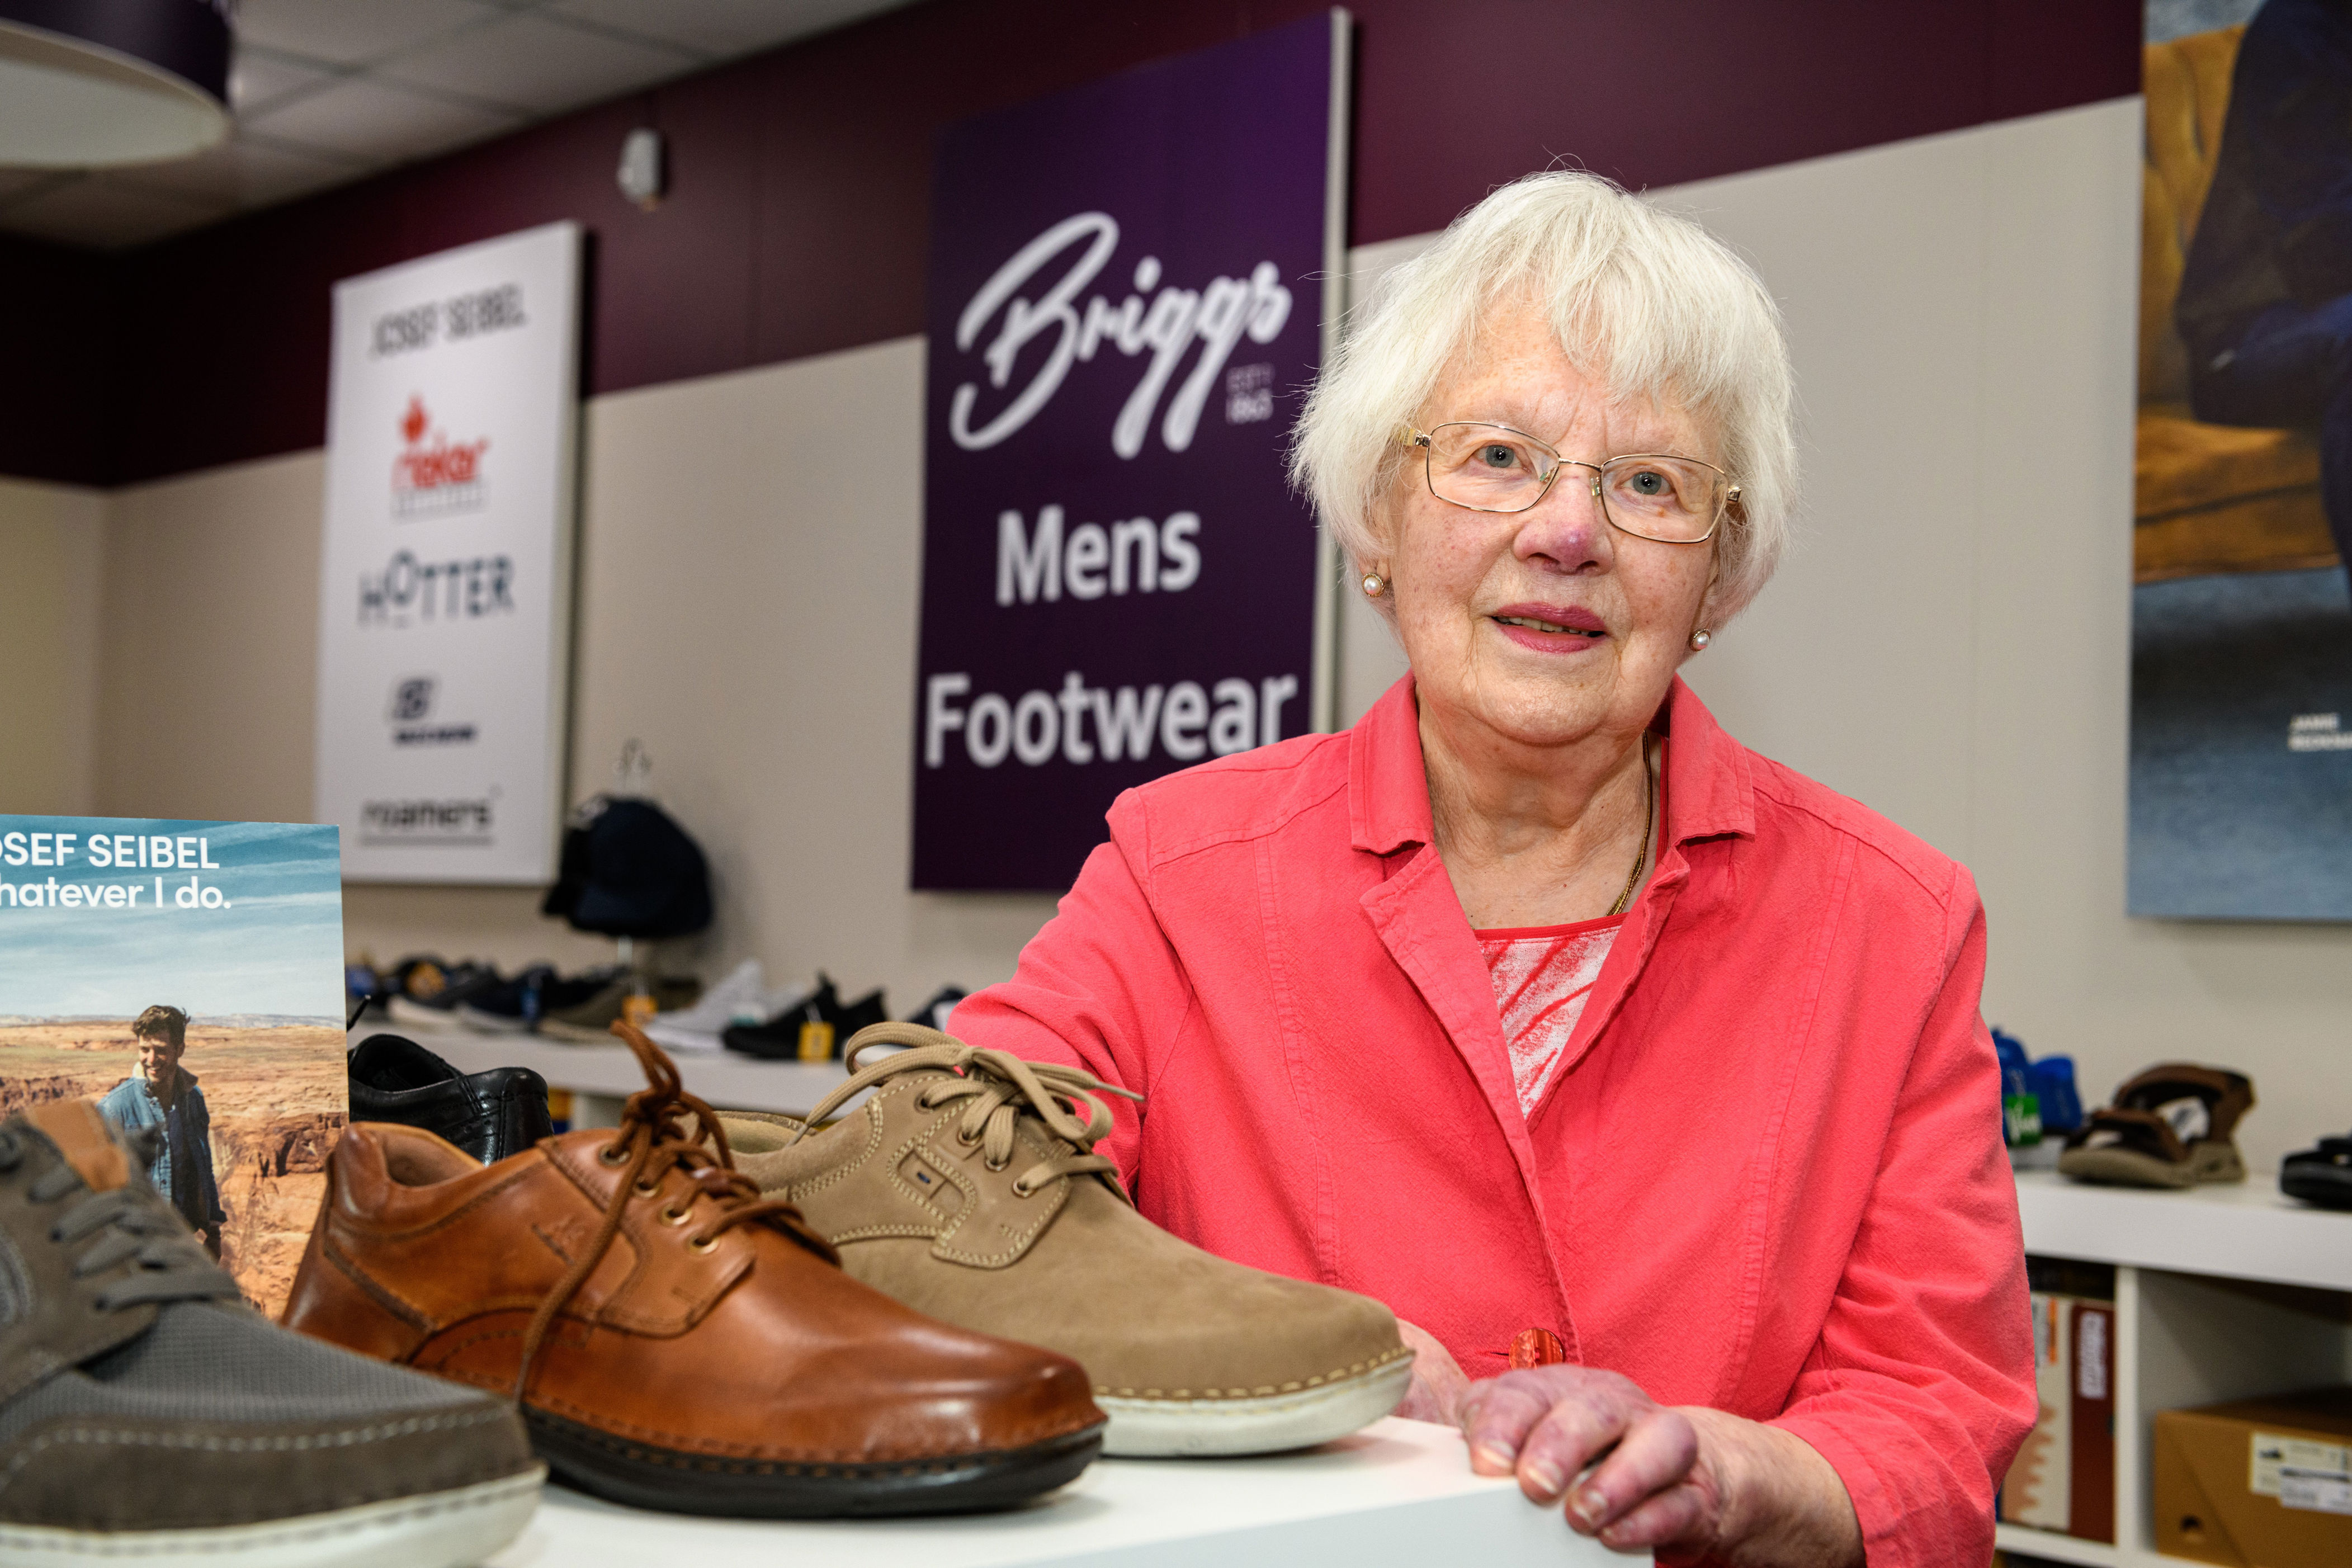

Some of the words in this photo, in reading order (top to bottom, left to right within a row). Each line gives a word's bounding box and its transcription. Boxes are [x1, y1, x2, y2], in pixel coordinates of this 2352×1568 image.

[950, 210, 1293, 460] Briggs
[357, 550, 516, 629] HOTTER
[995, 503, 1201, 606] Mens
[924, 671, 1298, 768] Footwear
[0, 832, 77, 866] SEF
[88, 834, 220, 869] SEIBEL
[155, 876, 163, 908] I
[175, 876, 232, 909] do.
